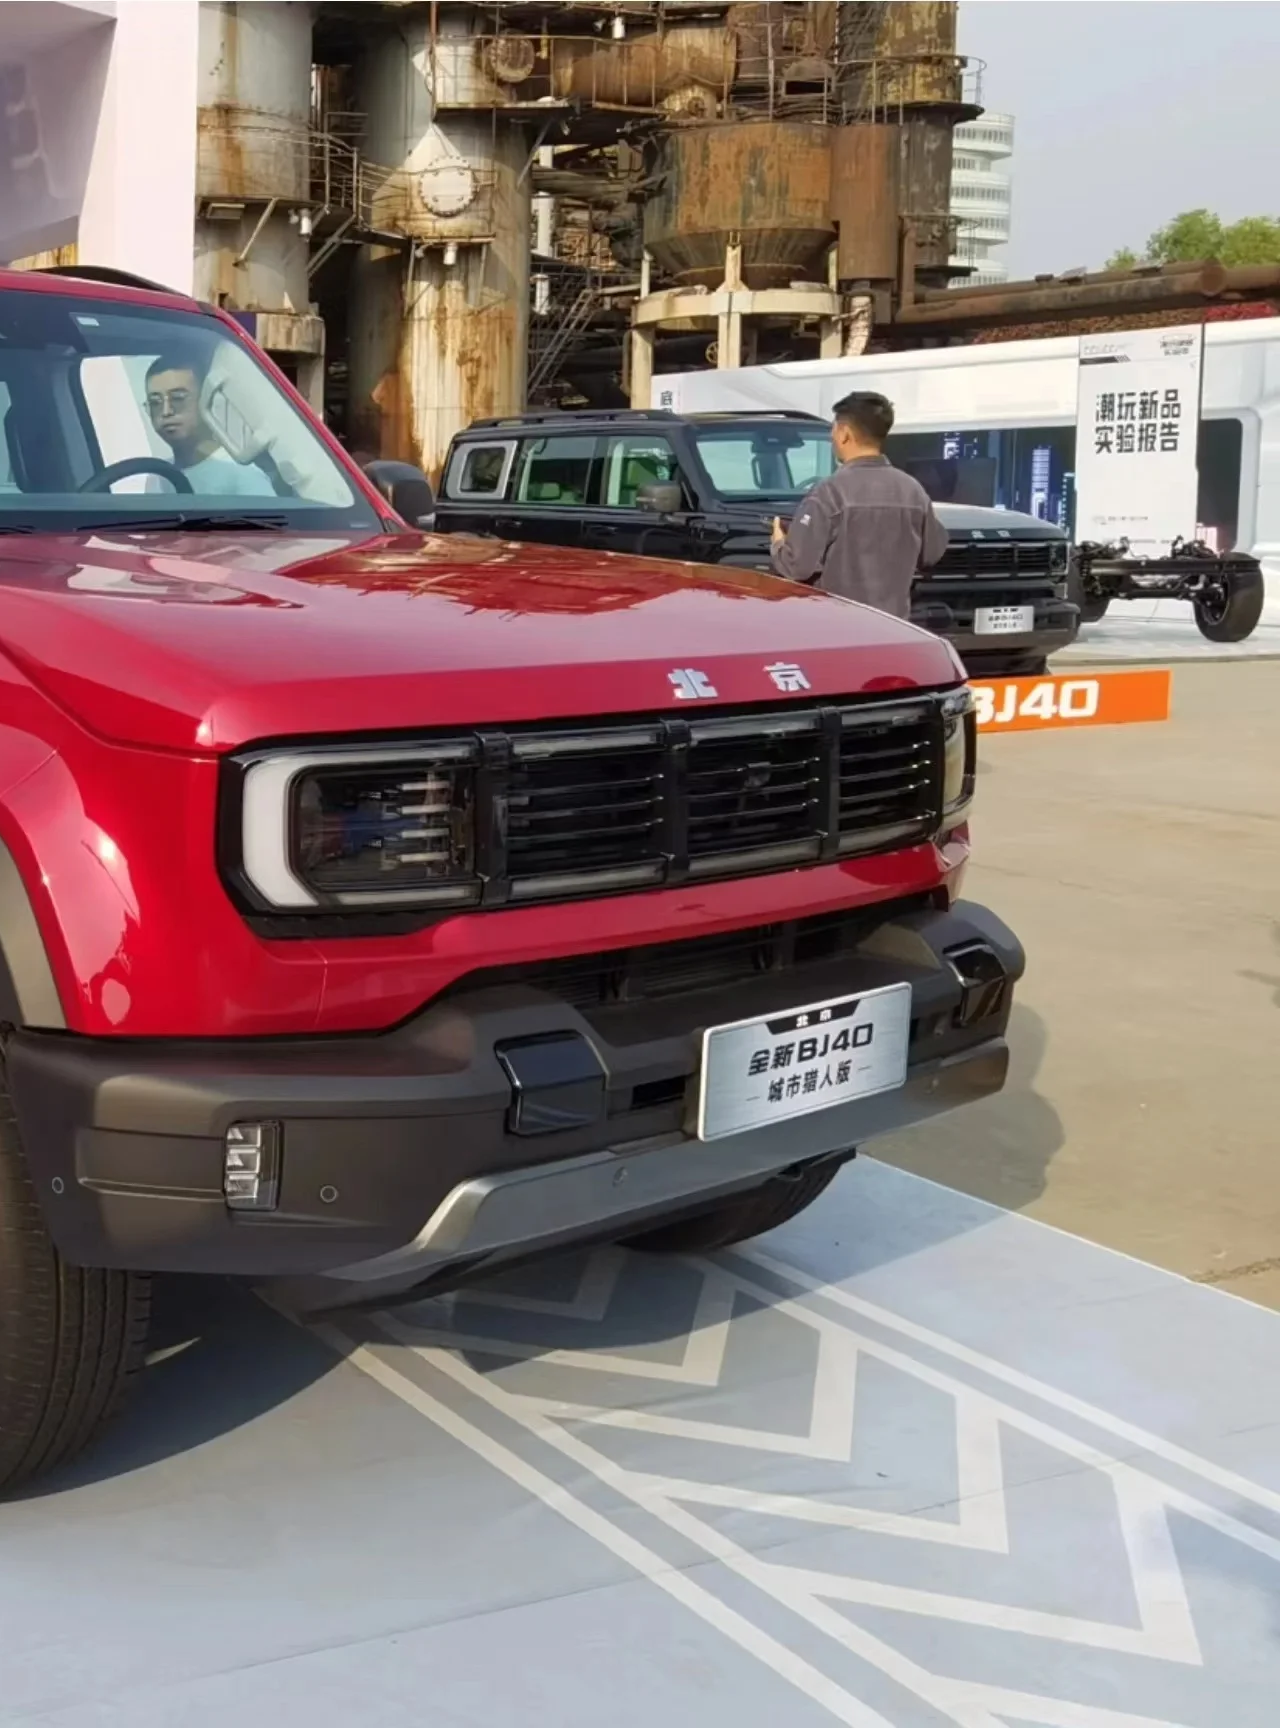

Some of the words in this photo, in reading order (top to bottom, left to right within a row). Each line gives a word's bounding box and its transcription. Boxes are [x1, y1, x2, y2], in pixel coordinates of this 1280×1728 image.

[1095, 388, 1181, 422] 潮玩新品
[1095, 422, 1179, 454] 实验报告
[667, 660, 813, 699] 北京
[970, 679, 1100, 724] BJ40
[796, 1008, 832, 1028] 北京
[747, 1022, 874, 1077] 全新BJ40
[767, 1059, 852, 1103] 城市猎人版
